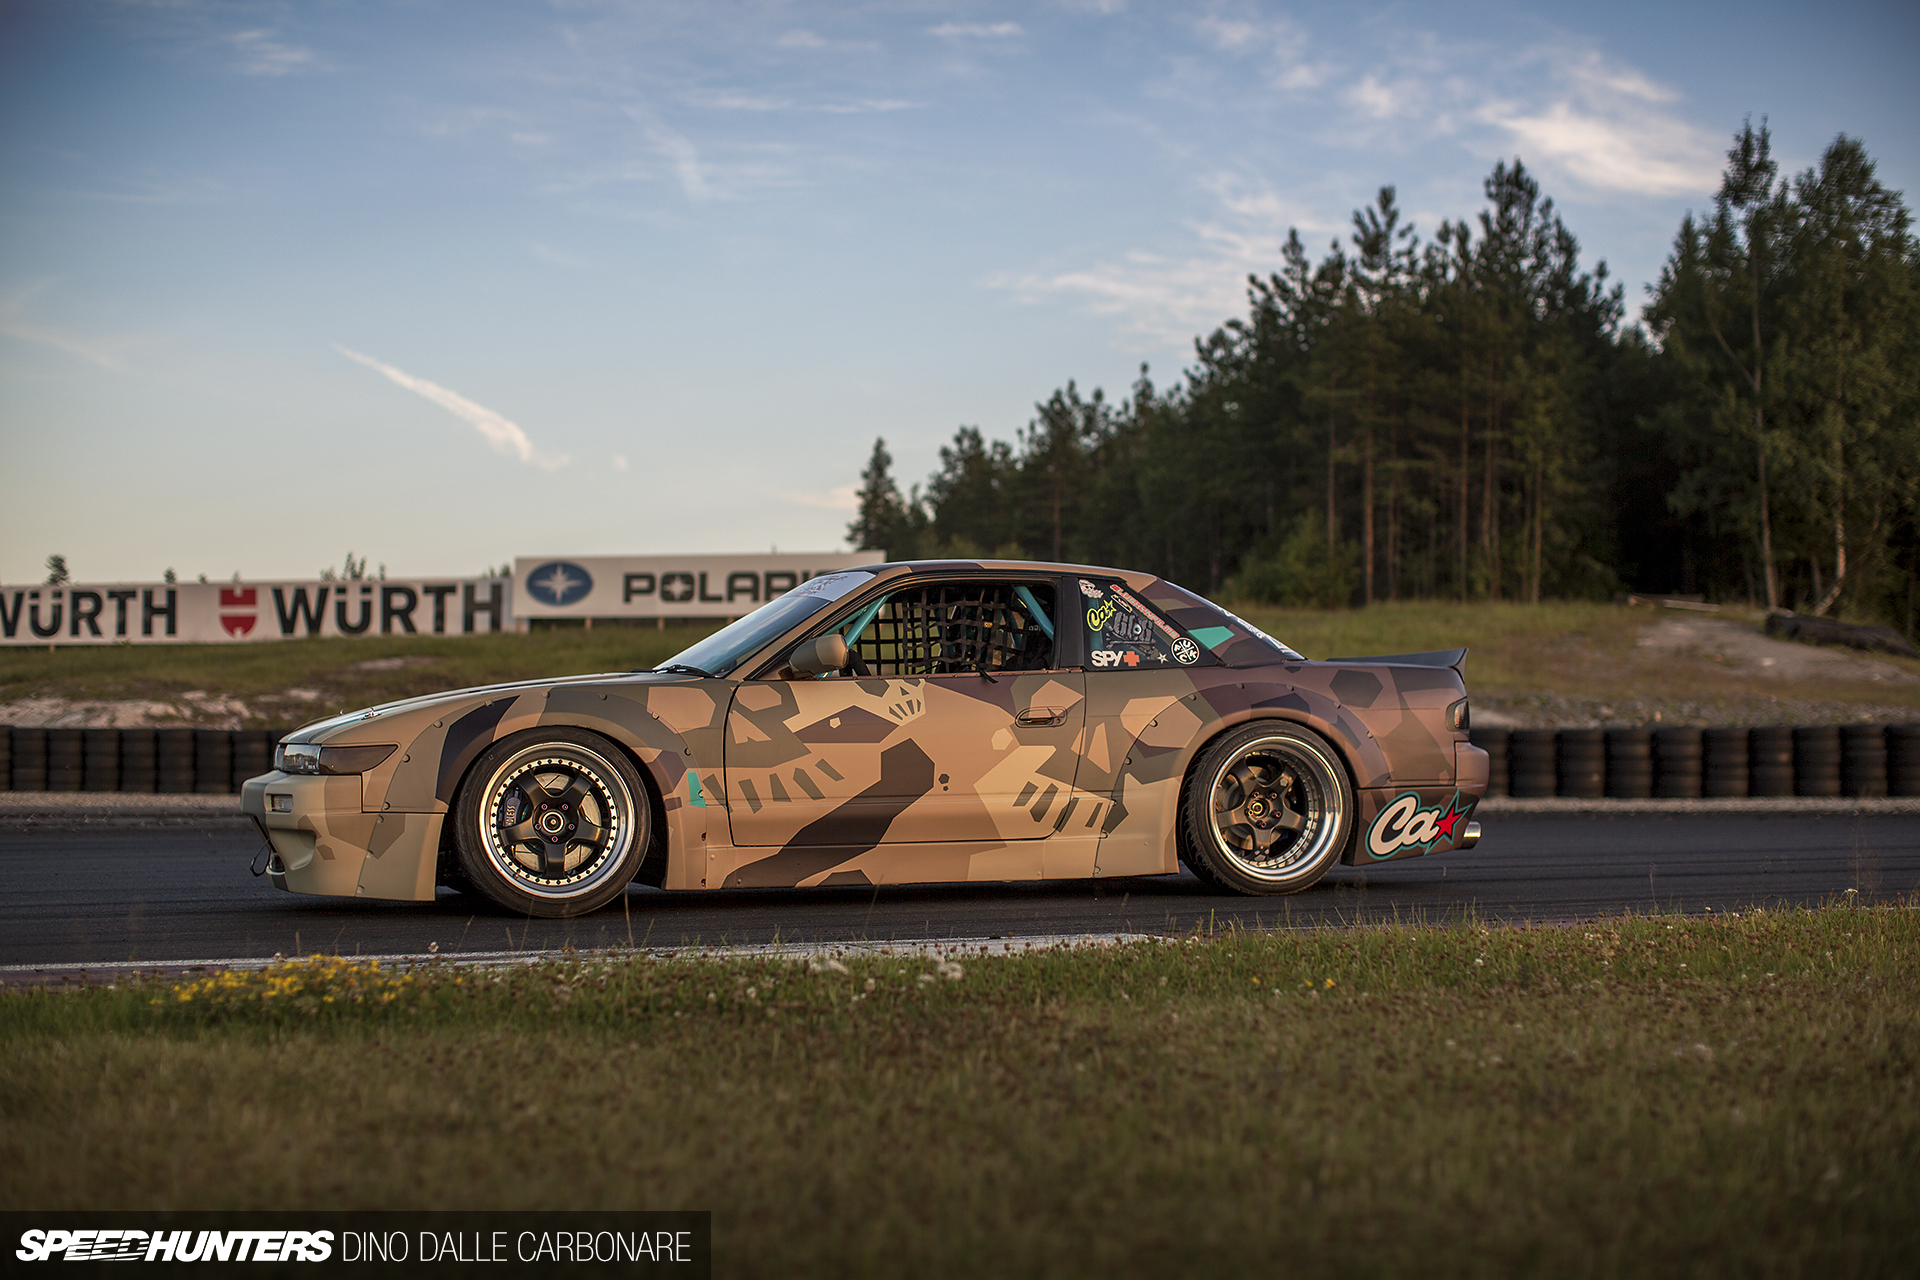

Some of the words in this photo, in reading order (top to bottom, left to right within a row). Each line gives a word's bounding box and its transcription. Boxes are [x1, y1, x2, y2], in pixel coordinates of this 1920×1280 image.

[623, 571, 838, 603] POLAR
[271, 584, 503, 635] WÜRTH
[1091, 650, 1124, 667] SPY
